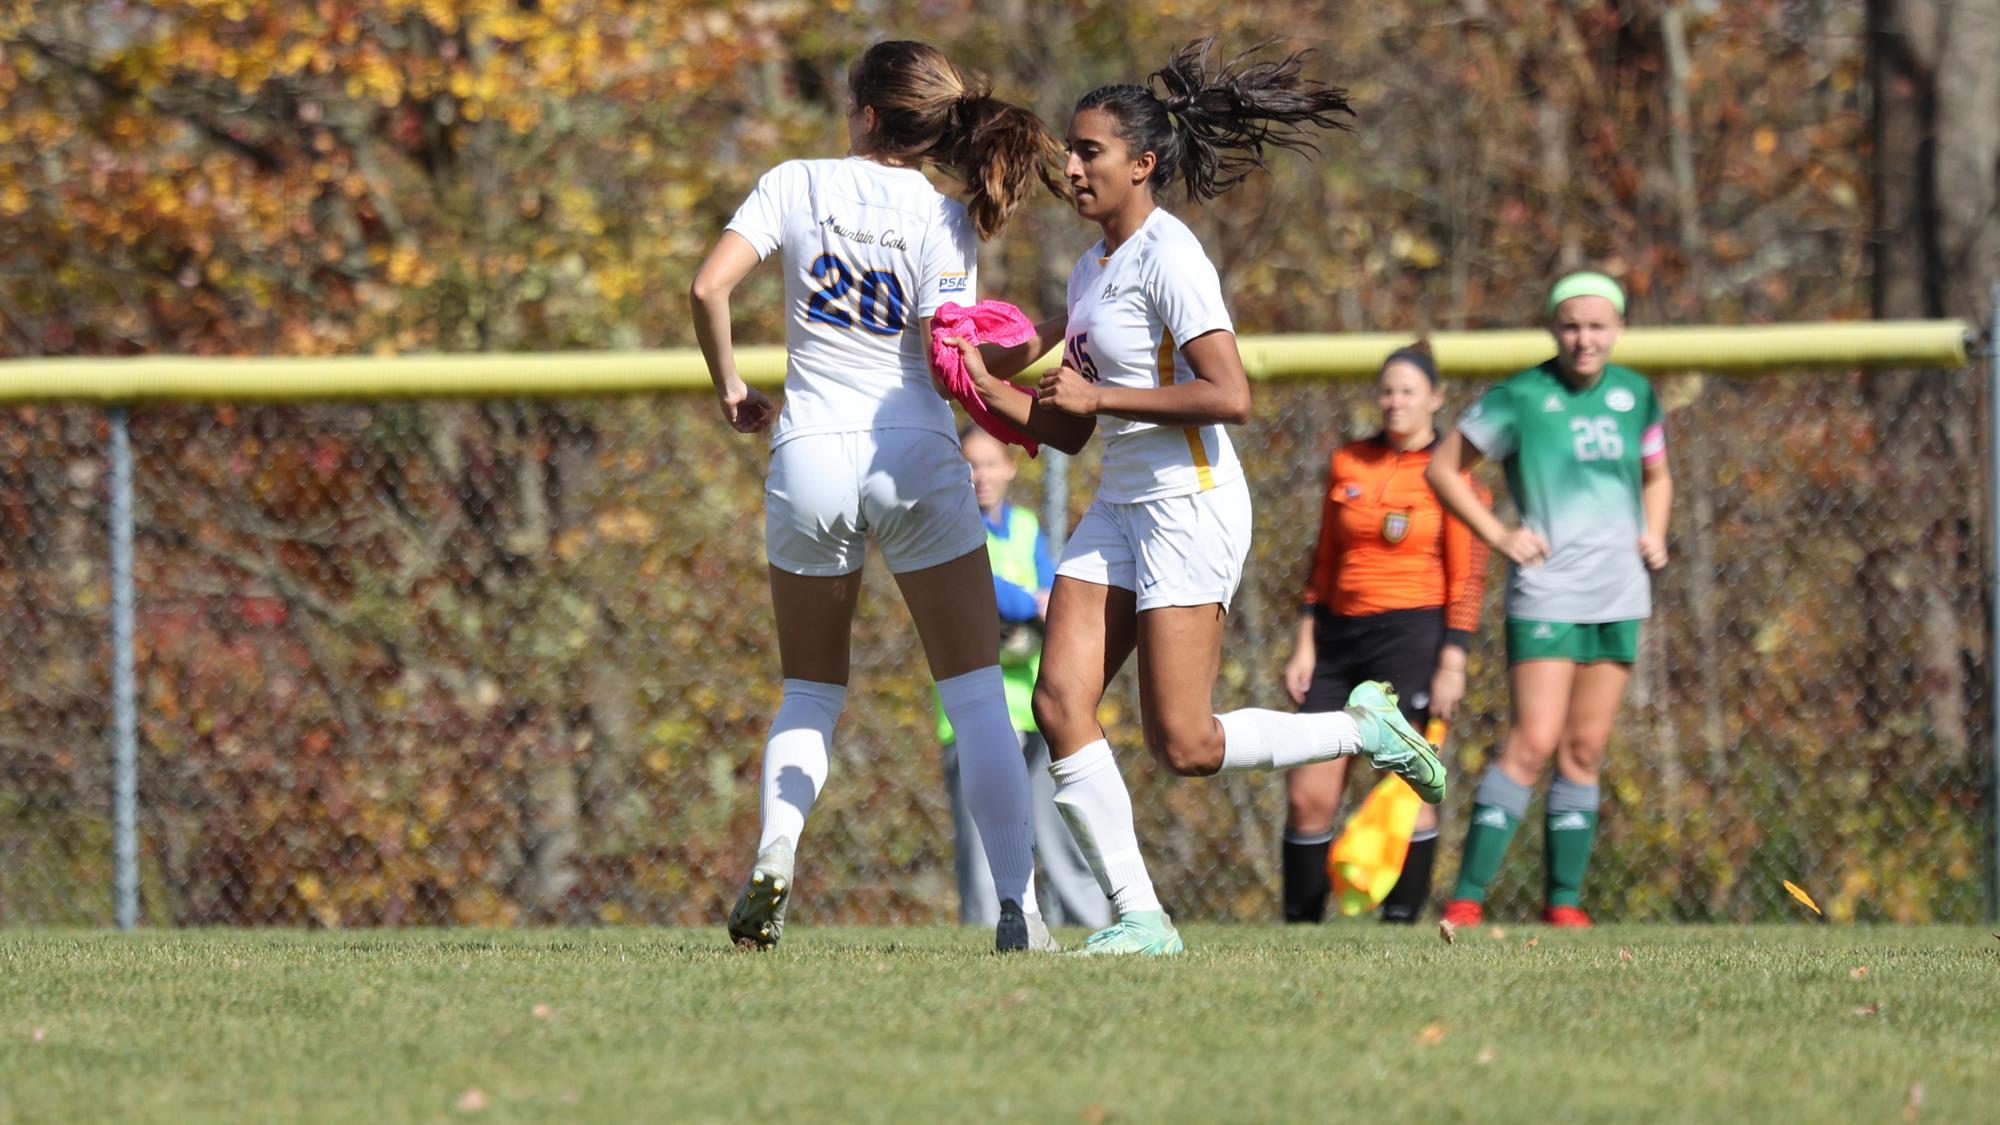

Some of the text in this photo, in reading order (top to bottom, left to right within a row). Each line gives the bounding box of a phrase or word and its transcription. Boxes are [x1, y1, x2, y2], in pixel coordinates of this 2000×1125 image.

[819, 214, 909, 251] Mountain Cats
[808, 251, 906, 337] 20
[939, 277, 967, 289] PSAC
[1069, 332, 1101, 383] 15
[1570, 416, 1624, 460] 26
